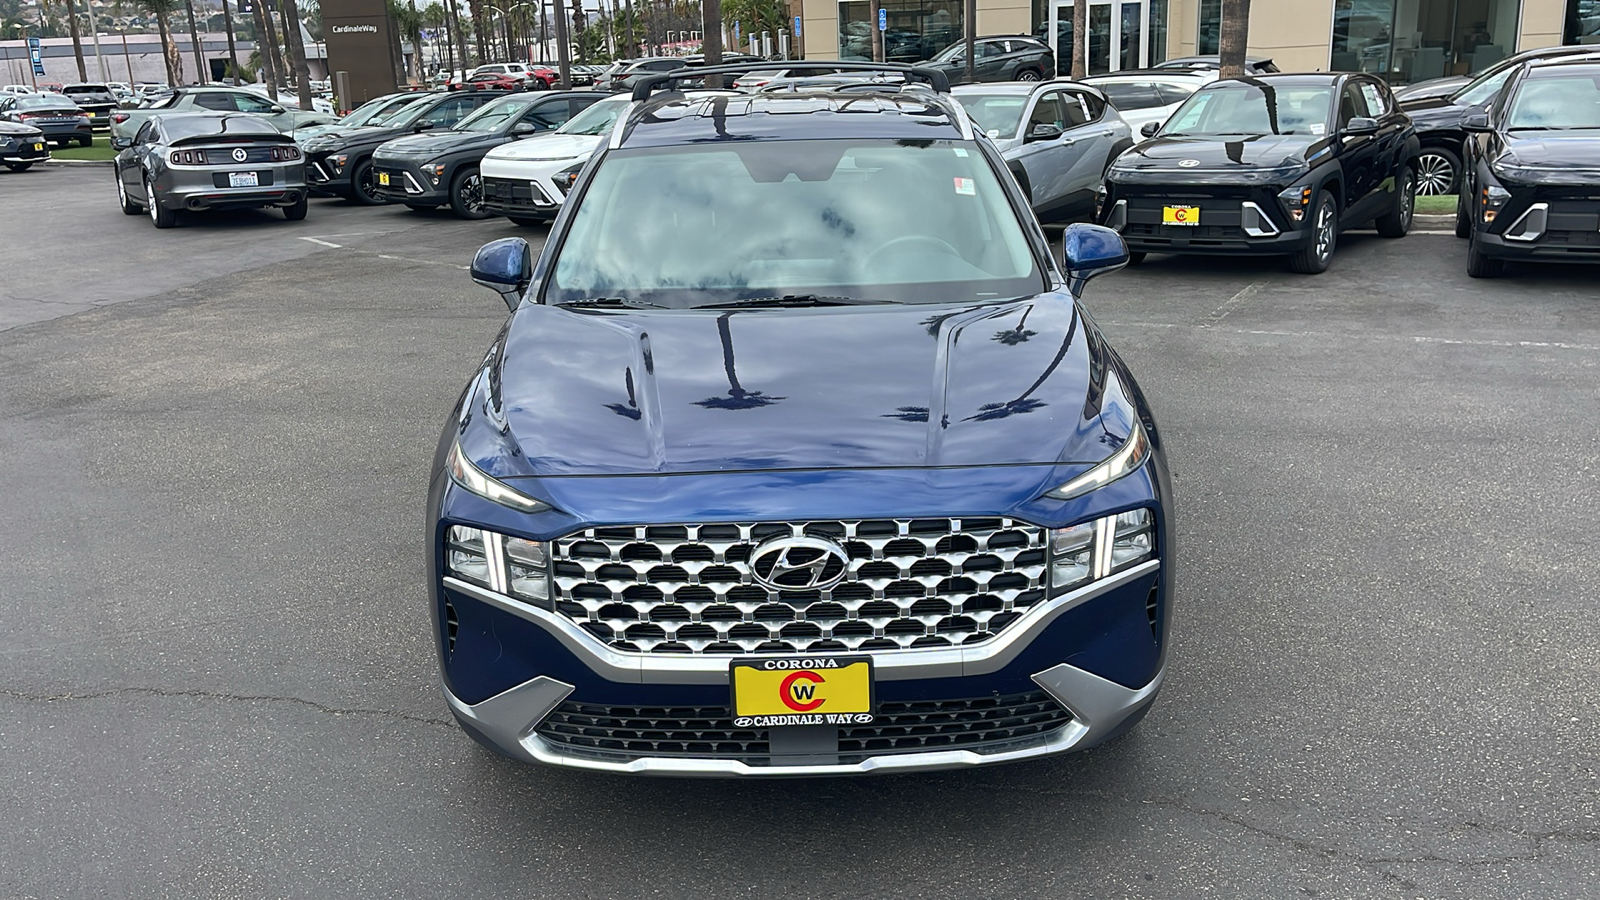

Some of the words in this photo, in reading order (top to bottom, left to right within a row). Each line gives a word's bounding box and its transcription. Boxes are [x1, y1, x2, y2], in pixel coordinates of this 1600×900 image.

[332, 24, 378, 33] CardinaleWay
[764, 658, 839, 670] CORONA
[779, 670, 826, 712] C
[793, 684, 816, 700] W
[754, 714, 824, 727] CARDINALE
[826, 713, 854, 725] WAY
